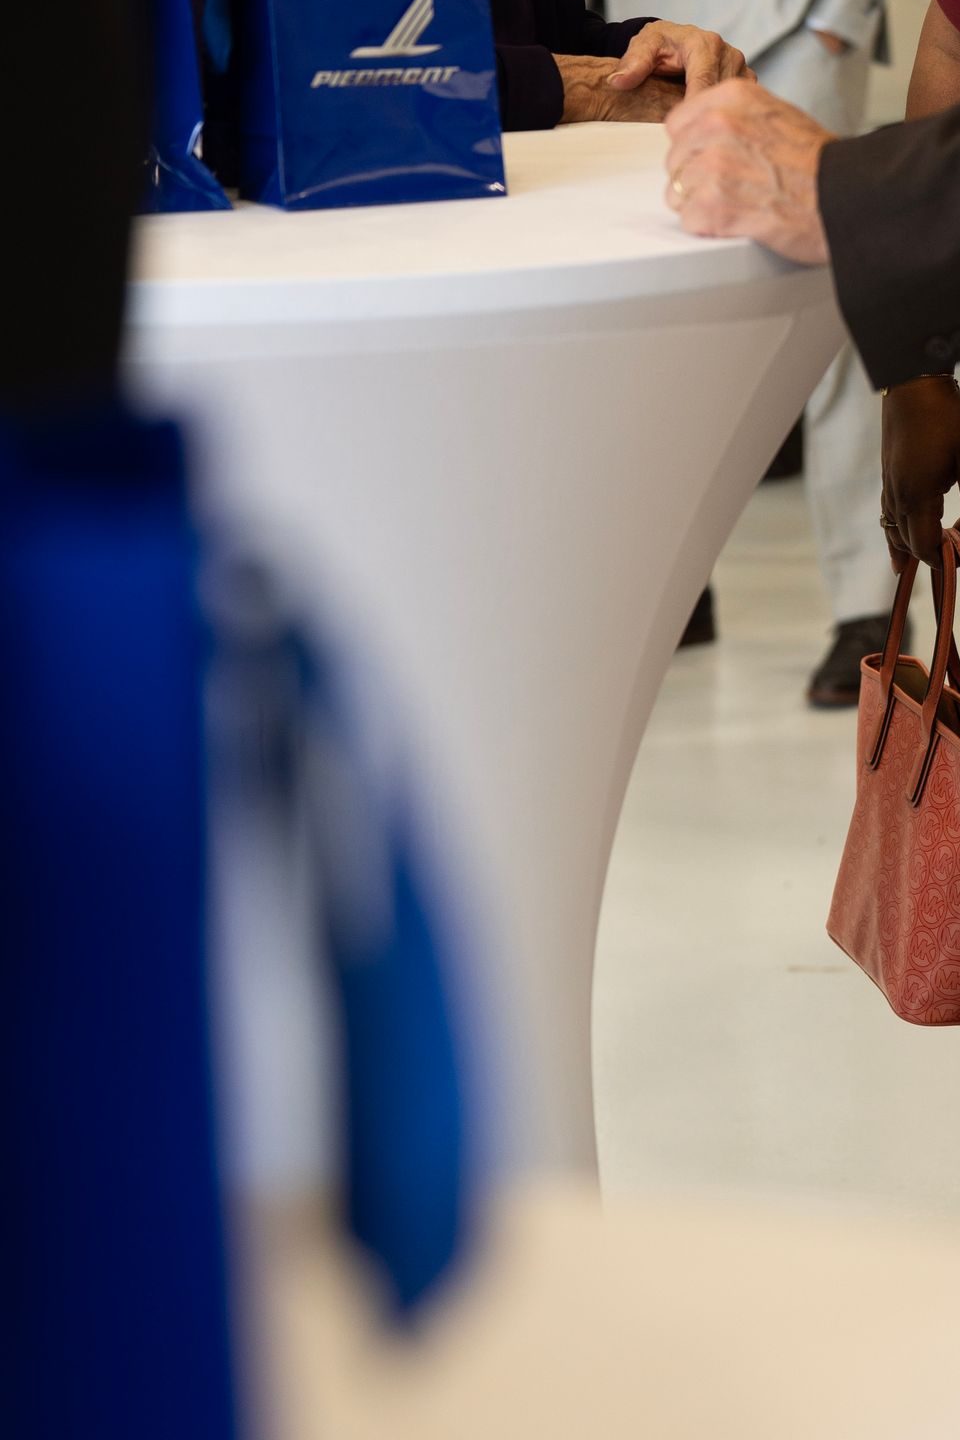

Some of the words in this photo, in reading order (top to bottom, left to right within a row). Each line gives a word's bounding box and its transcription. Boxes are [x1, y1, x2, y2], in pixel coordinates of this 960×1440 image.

[311, 66, 459, 88] PIEDMONT
[921, 892, 944, 920] MK
[910, 934, 936, 960] MK
[903, 977, 929, 1005] MK
